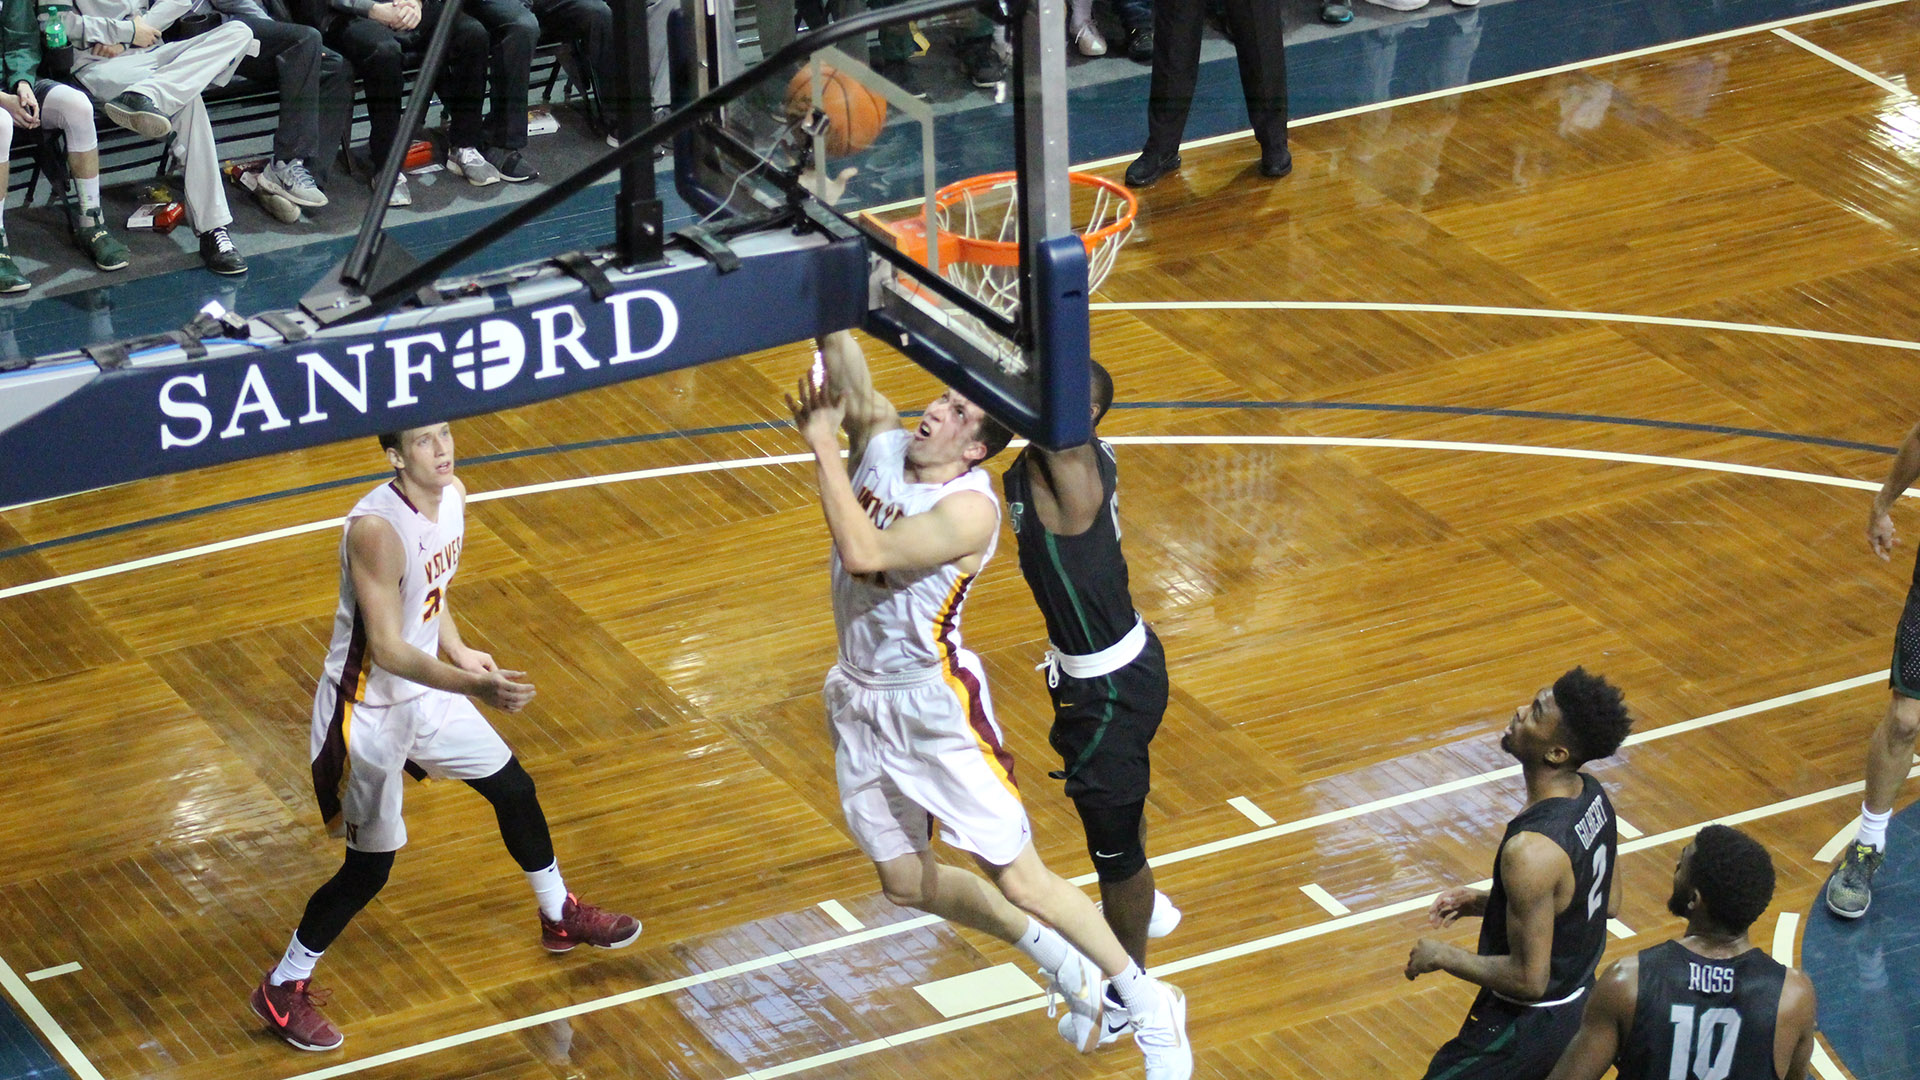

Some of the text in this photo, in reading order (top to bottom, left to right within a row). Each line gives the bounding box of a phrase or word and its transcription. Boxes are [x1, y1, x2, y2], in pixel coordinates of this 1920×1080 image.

[159, 289, 679, 450] SANFORD
[1574, 794, 1608, 850] GILBERT
[1588, 843, 1607, 921] 2
[1688, 962, 1734, 993] ROSS
[1668, 1004, 1742, 1080] 10
